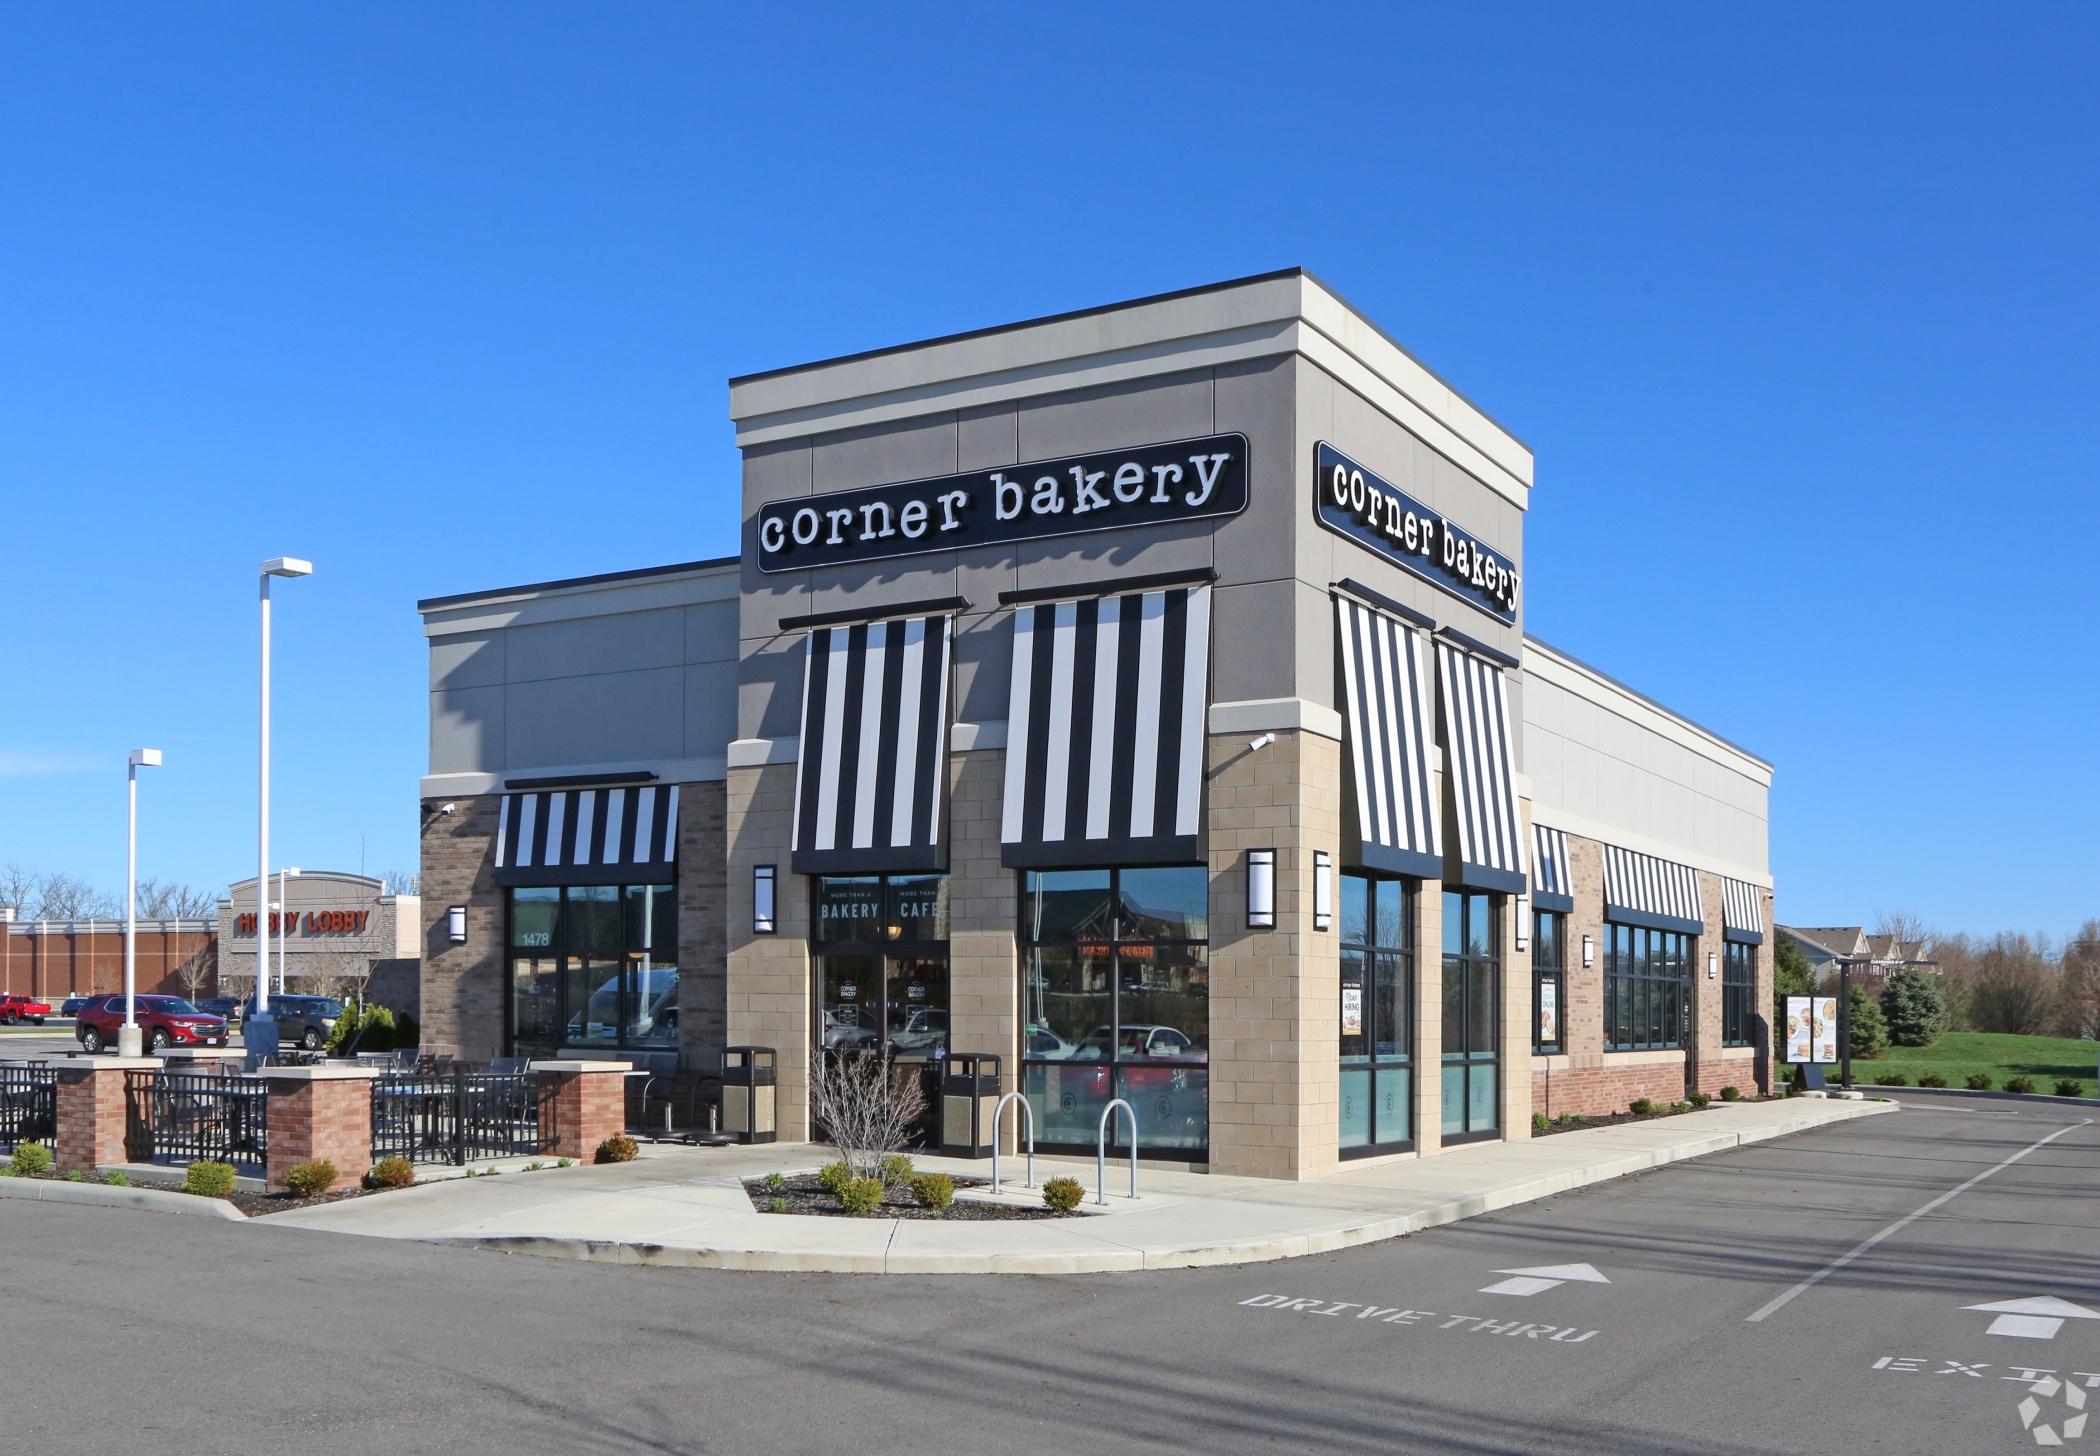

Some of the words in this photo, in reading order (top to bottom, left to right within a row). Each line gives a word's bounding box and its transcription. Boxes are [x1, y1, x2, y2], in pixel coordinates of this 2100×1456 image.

[760, 489, 970, 553] corner
[990, 453, 1231, 520] bakery
[1333, 464, 1434, 555] corner
[1442, 518, 1522, 612] bakery
[821, 903, 878, 918] BAKERY
[900, 902, 938, 917] CAFE
[308, 910, 370, 932] LOBBY
[523, 933, 549, 946] 1478
[1237, 1294, 1437, 1325] DRIVE
[1439, 1314, 1600, 1343] THRU
